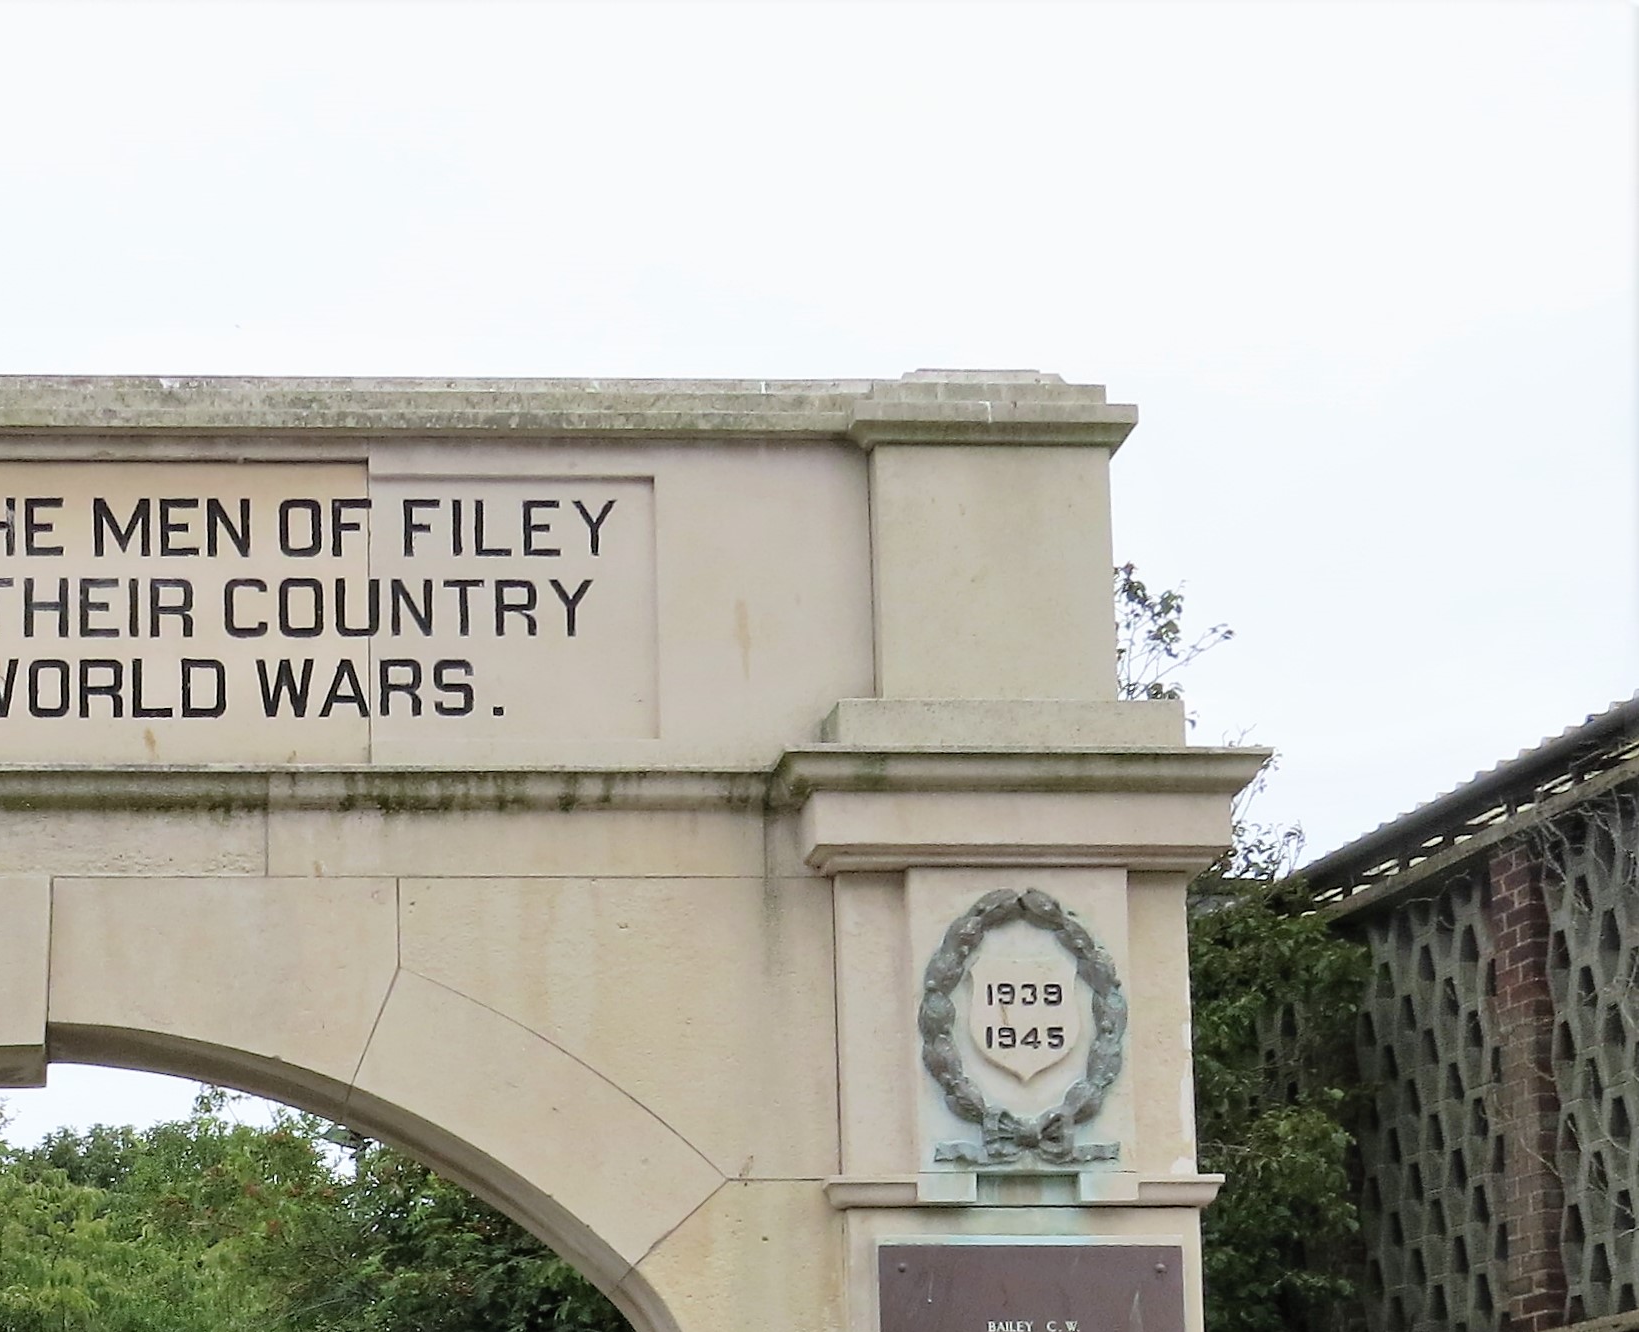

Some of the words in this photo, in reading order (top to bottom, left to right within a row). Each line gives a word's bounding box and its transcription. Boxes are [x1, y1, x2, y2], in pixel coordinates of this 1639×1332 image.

[92, 498, 251, 557] MEN
[279, 498, 372, 557] OF
[402, 499, 616, 557] FILEY
[223, 577, 593, 638] COUNTRY
[255, 658, 504, 718] WARS.
[986, 983, 1063, 1006] 1939
[985, 1026, 1065, 1049] 1945
[988, 1321, 1033, 1332] BAILEY
